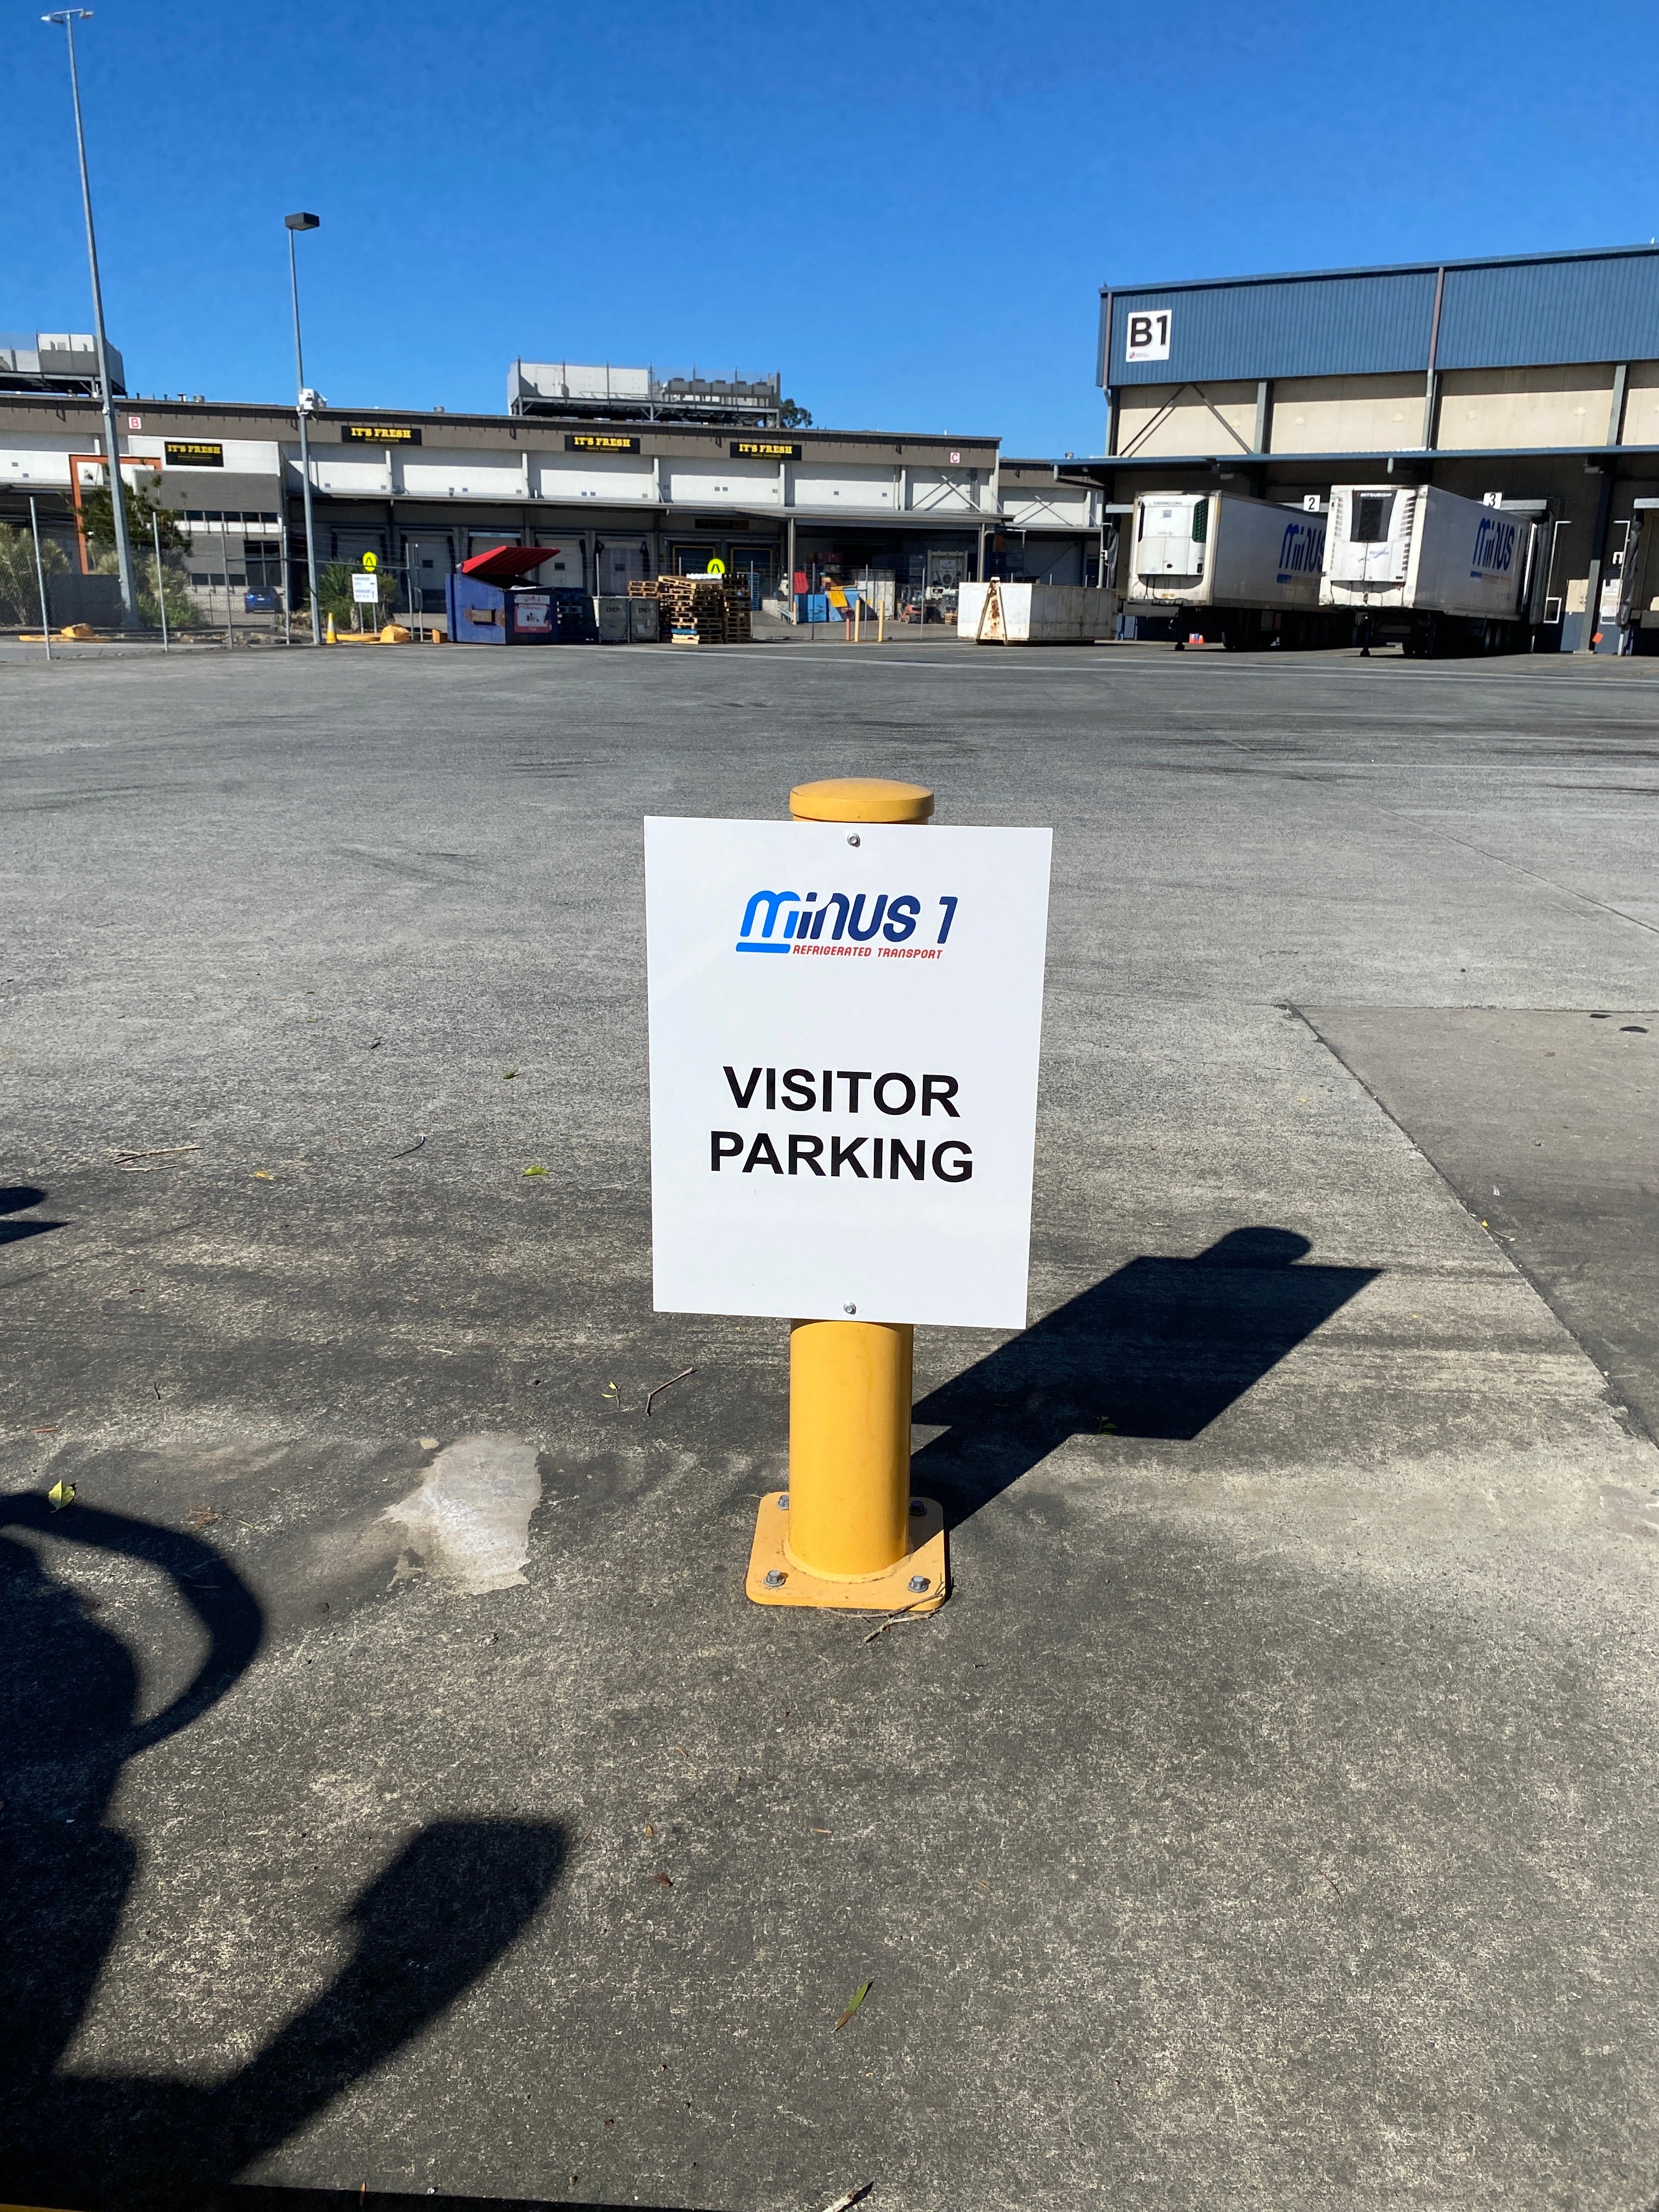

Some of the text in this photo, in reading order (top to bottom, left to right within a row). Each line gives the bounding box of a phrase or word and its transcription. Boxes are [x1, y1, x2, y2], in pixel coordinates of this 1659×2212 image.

[1130, 315, 1167, 347] B1
[131, 417, 139, 428] B
[351, 428, 411, 438] IT'S FRESH
[596, 438, 631, 447] FRESH
[739, 444, 793, 454] IT'S FRESH
[188, 445, 221, 454] FRESH
[952, 453, 958, 462] C
[1308, 497, 1315, 510] 2
[1488, 493, 1496, 507] 3
[937, 896, 958, 944] 1
[792, 945, 943, 959] REFRIGERATED TRANSPORT
[723, 1066, 961, 1118] VISITOR
[710, 1130, 973, 1183] PARKING
